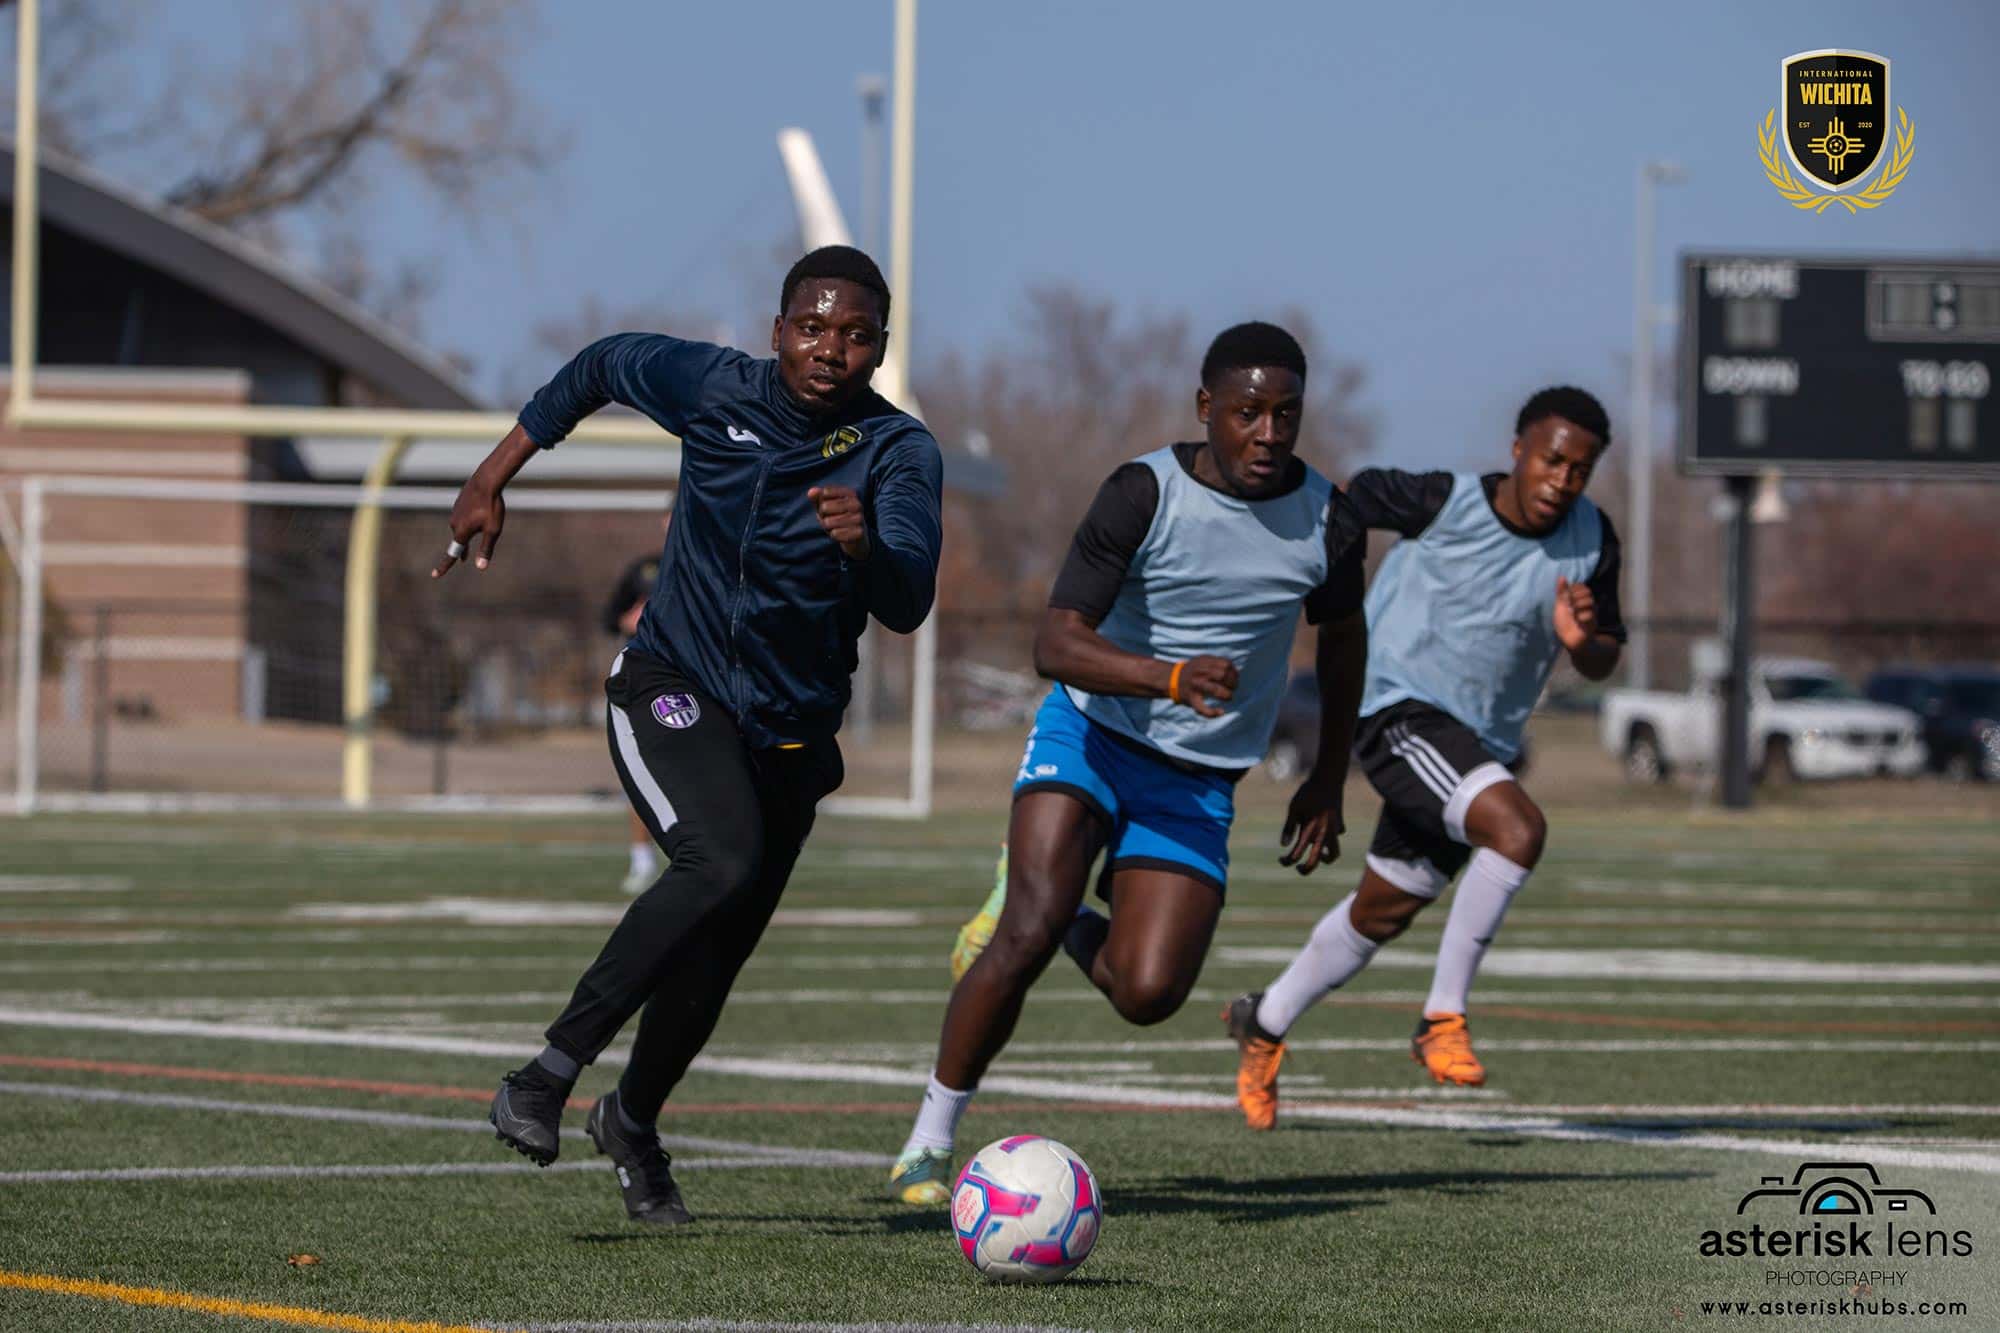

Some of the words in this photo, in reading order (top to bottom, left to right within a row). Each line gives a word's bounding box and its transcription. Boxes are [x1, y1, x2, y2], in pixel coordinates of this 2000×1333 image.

[1705, 262, 1798, 300] HOME
[1704, 356, 1799, 395] DOWN
[1901, 359, 1942, 397] TO
[1943, 360, 1990, 399] GO
